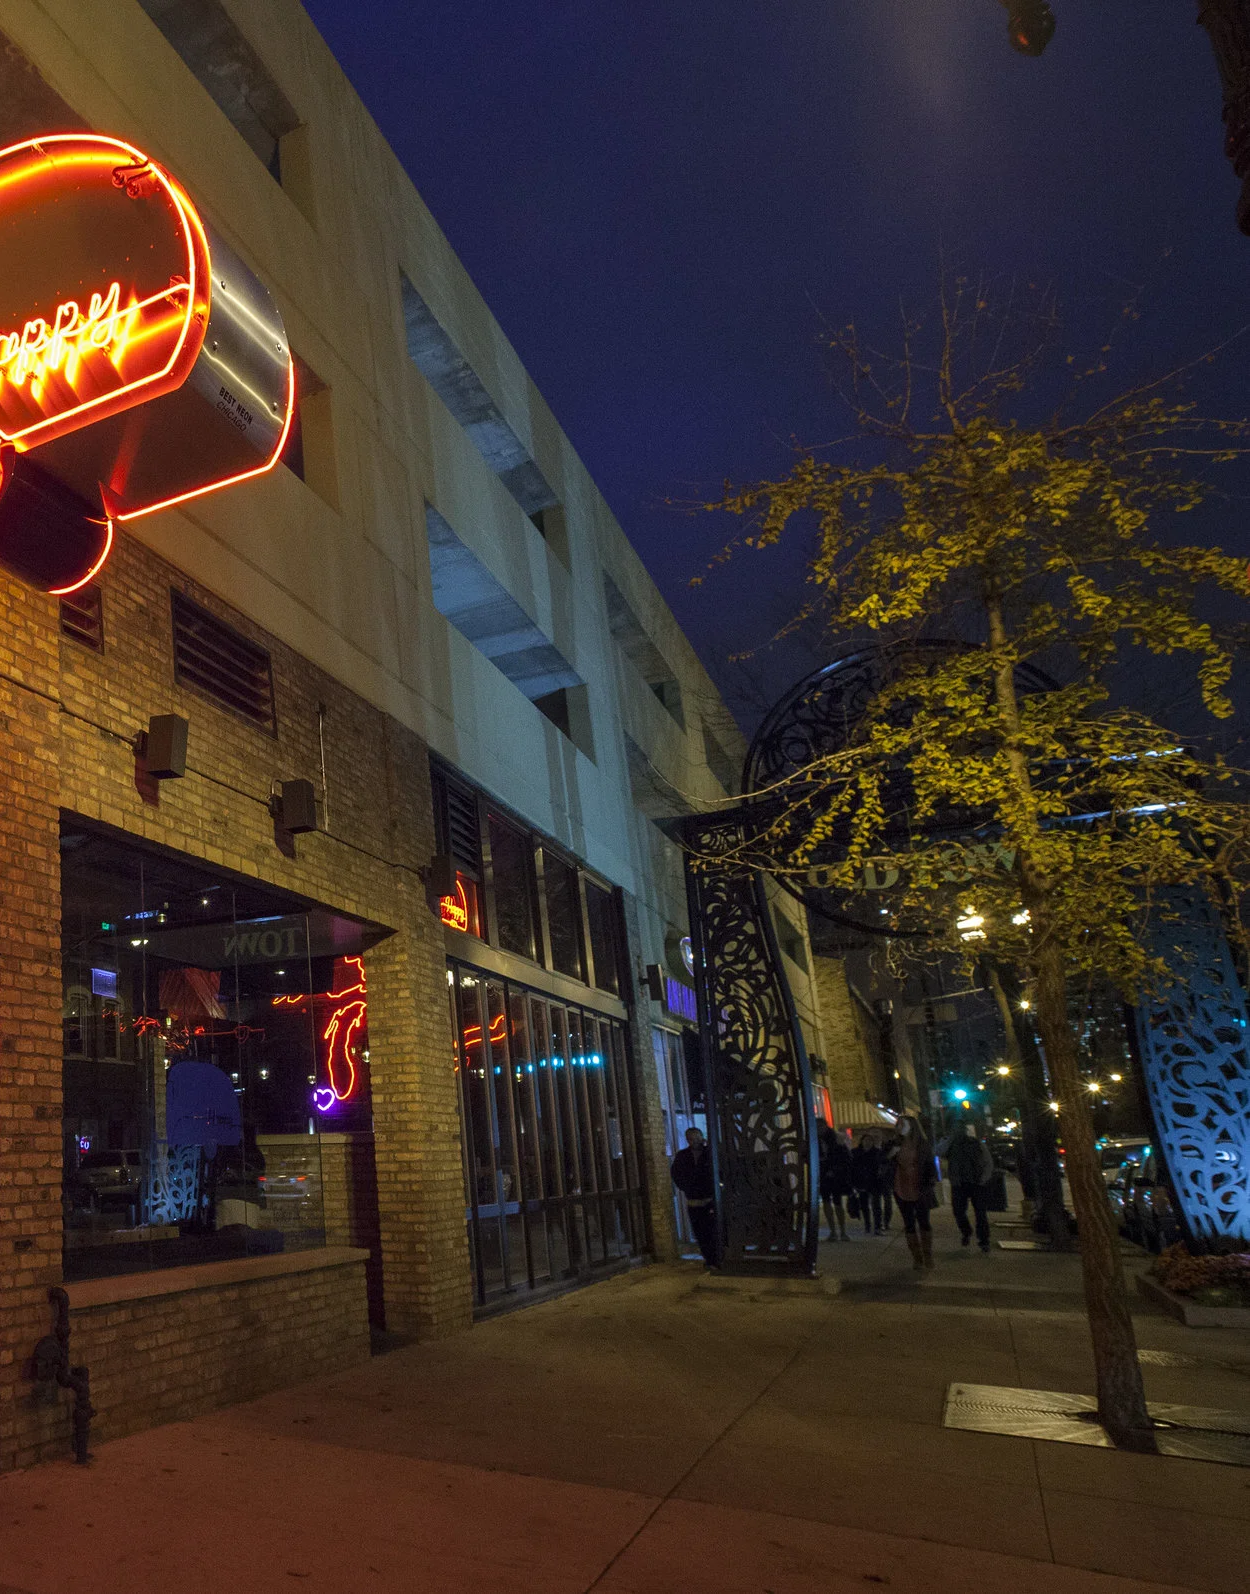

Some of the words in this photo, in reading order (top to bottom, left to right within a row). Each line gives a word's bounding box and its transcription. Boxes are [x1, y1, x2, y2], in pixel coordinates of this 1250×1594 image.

[216, 401, 247, 432] CHICAGO
[219, 387, 236, 407] BEST
[236, 403, 254, 425] NEON
